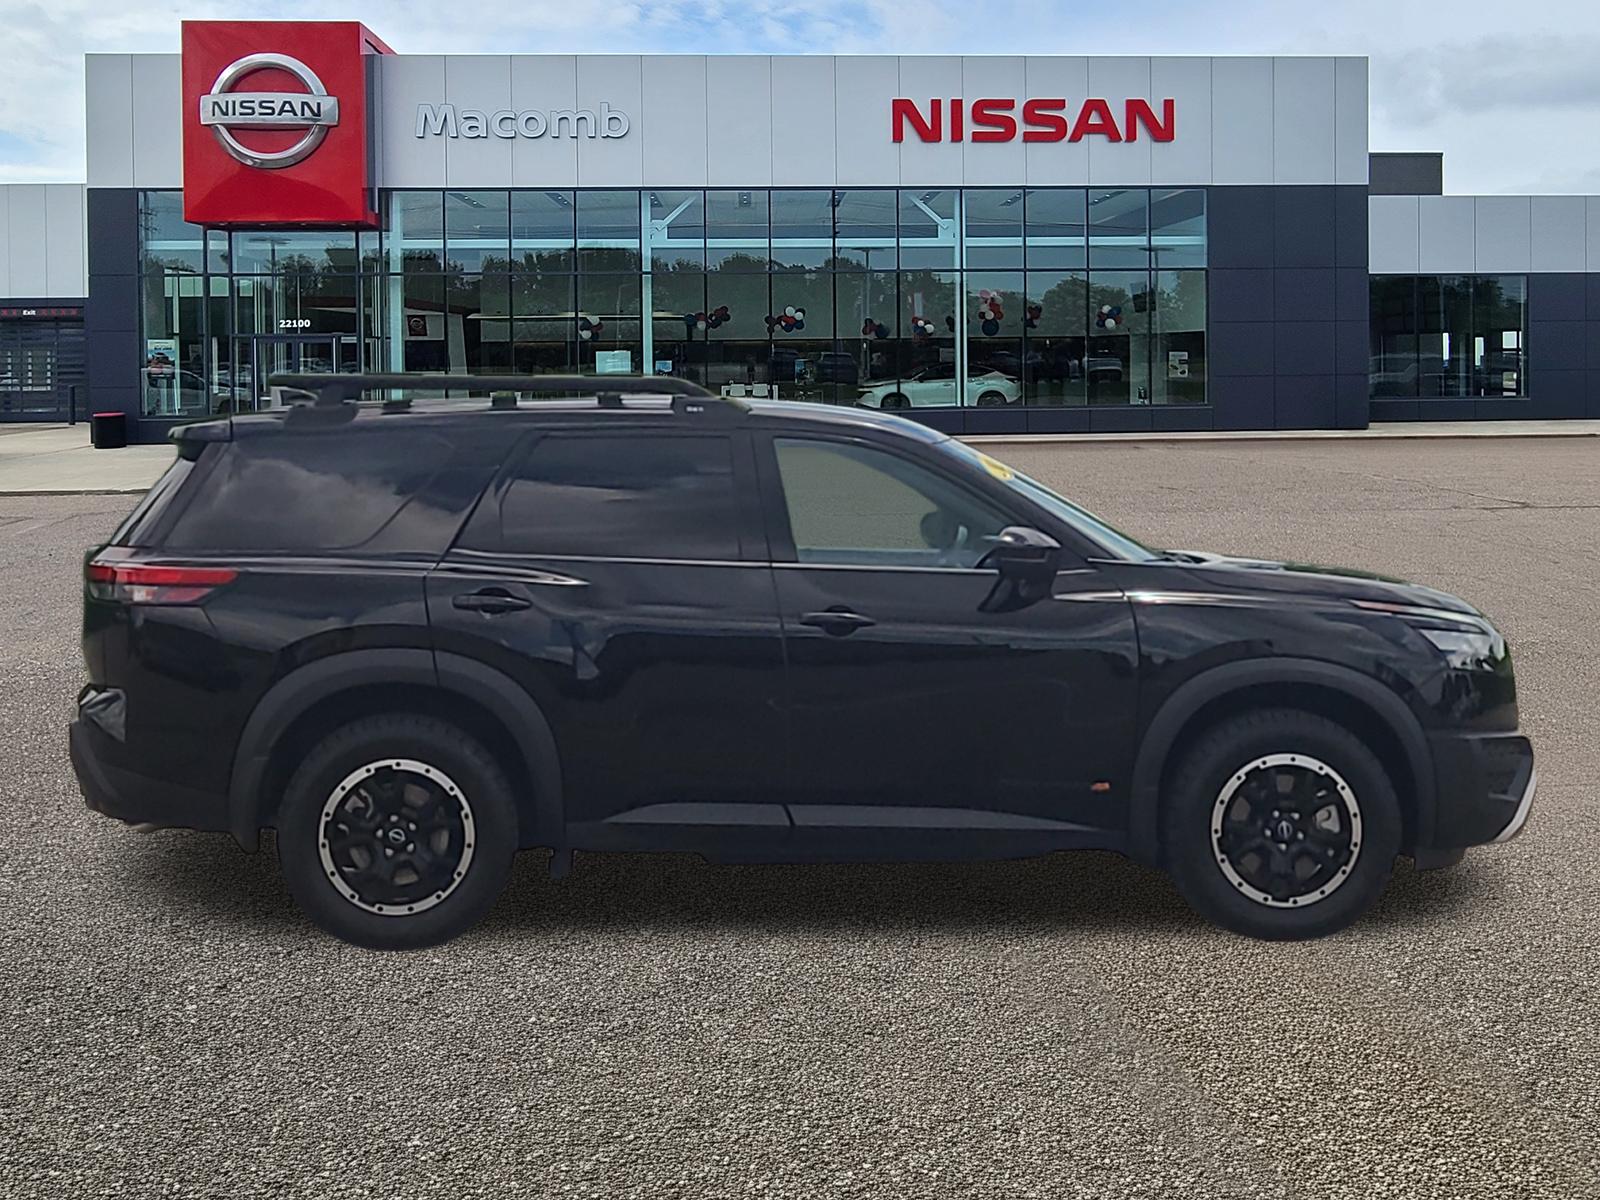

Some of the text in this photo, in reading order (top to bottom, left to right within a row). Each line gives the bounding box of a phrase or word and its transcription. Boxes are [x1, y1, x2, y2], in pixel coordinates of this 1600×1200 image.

[211, 100, 322, 117] NISSAN
[415, 102, 630, 139] Macomb
[892, 98, 1175, 143] NISSAN
[279, 319, 311, 328] 22100
